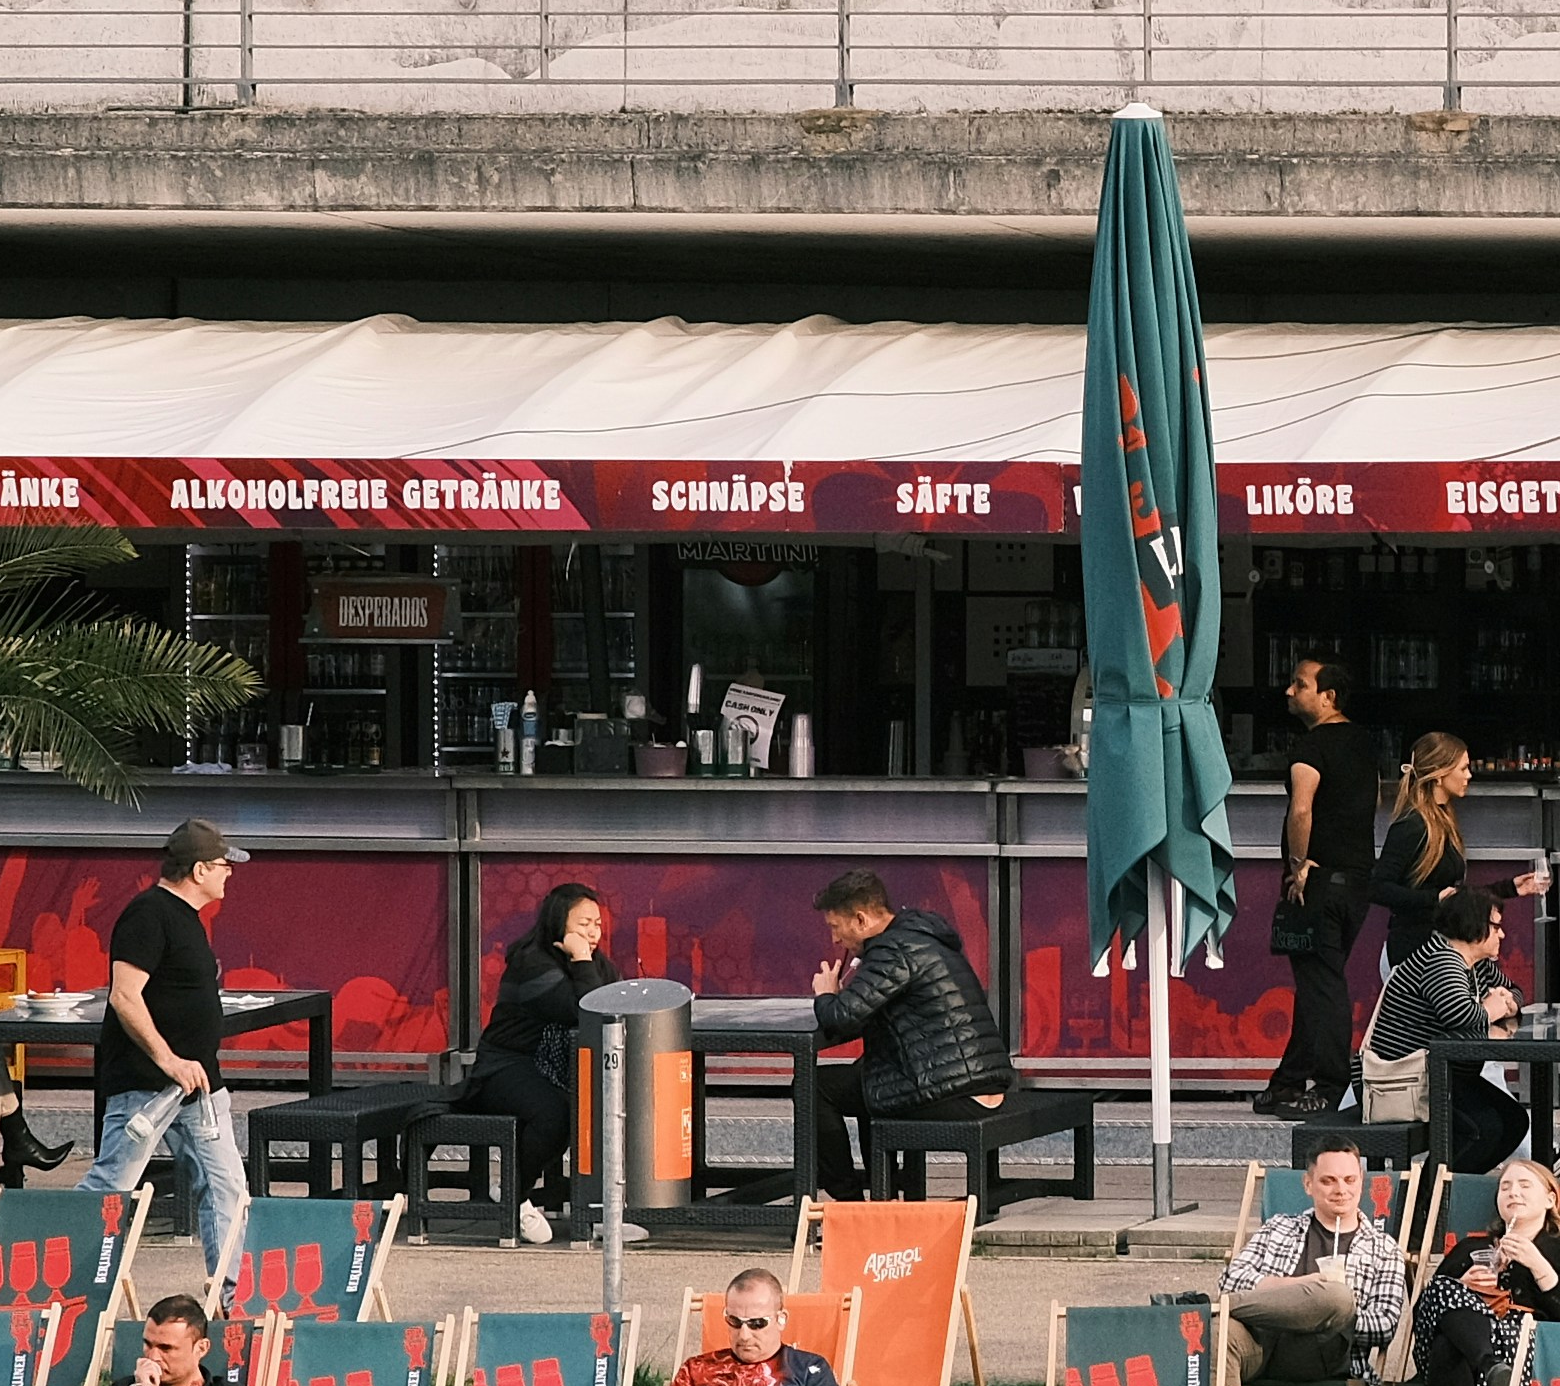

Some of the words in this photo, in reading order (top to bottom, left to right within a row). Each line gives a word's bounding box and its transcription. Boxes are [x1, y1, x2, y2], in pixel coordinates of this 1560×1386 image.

[171, 478, 388, 511] ALKOHOLFREIE
[403, 473, 560, 510] GETRÄNKE
[651, 475, 805, 512] SCHNÄPSE
[896, 477, 991, 514] SÄFTE
[1245, 478, 1354, 515] LIKÖRE
[338, 596, 428, 628] DESPERADOS
[725, 700, 750, 711] CASH
[751, 706, 774, 717] ONLY
[603, 1053, 619, 1070] 29
[95, 1236, 115, 1284] BERLINER
[346, 1243, 366, 1293] BERLINER
[863, 1246, 922, 1275] APEROL
[873, 1263, 912, 1282] SPRITZ
